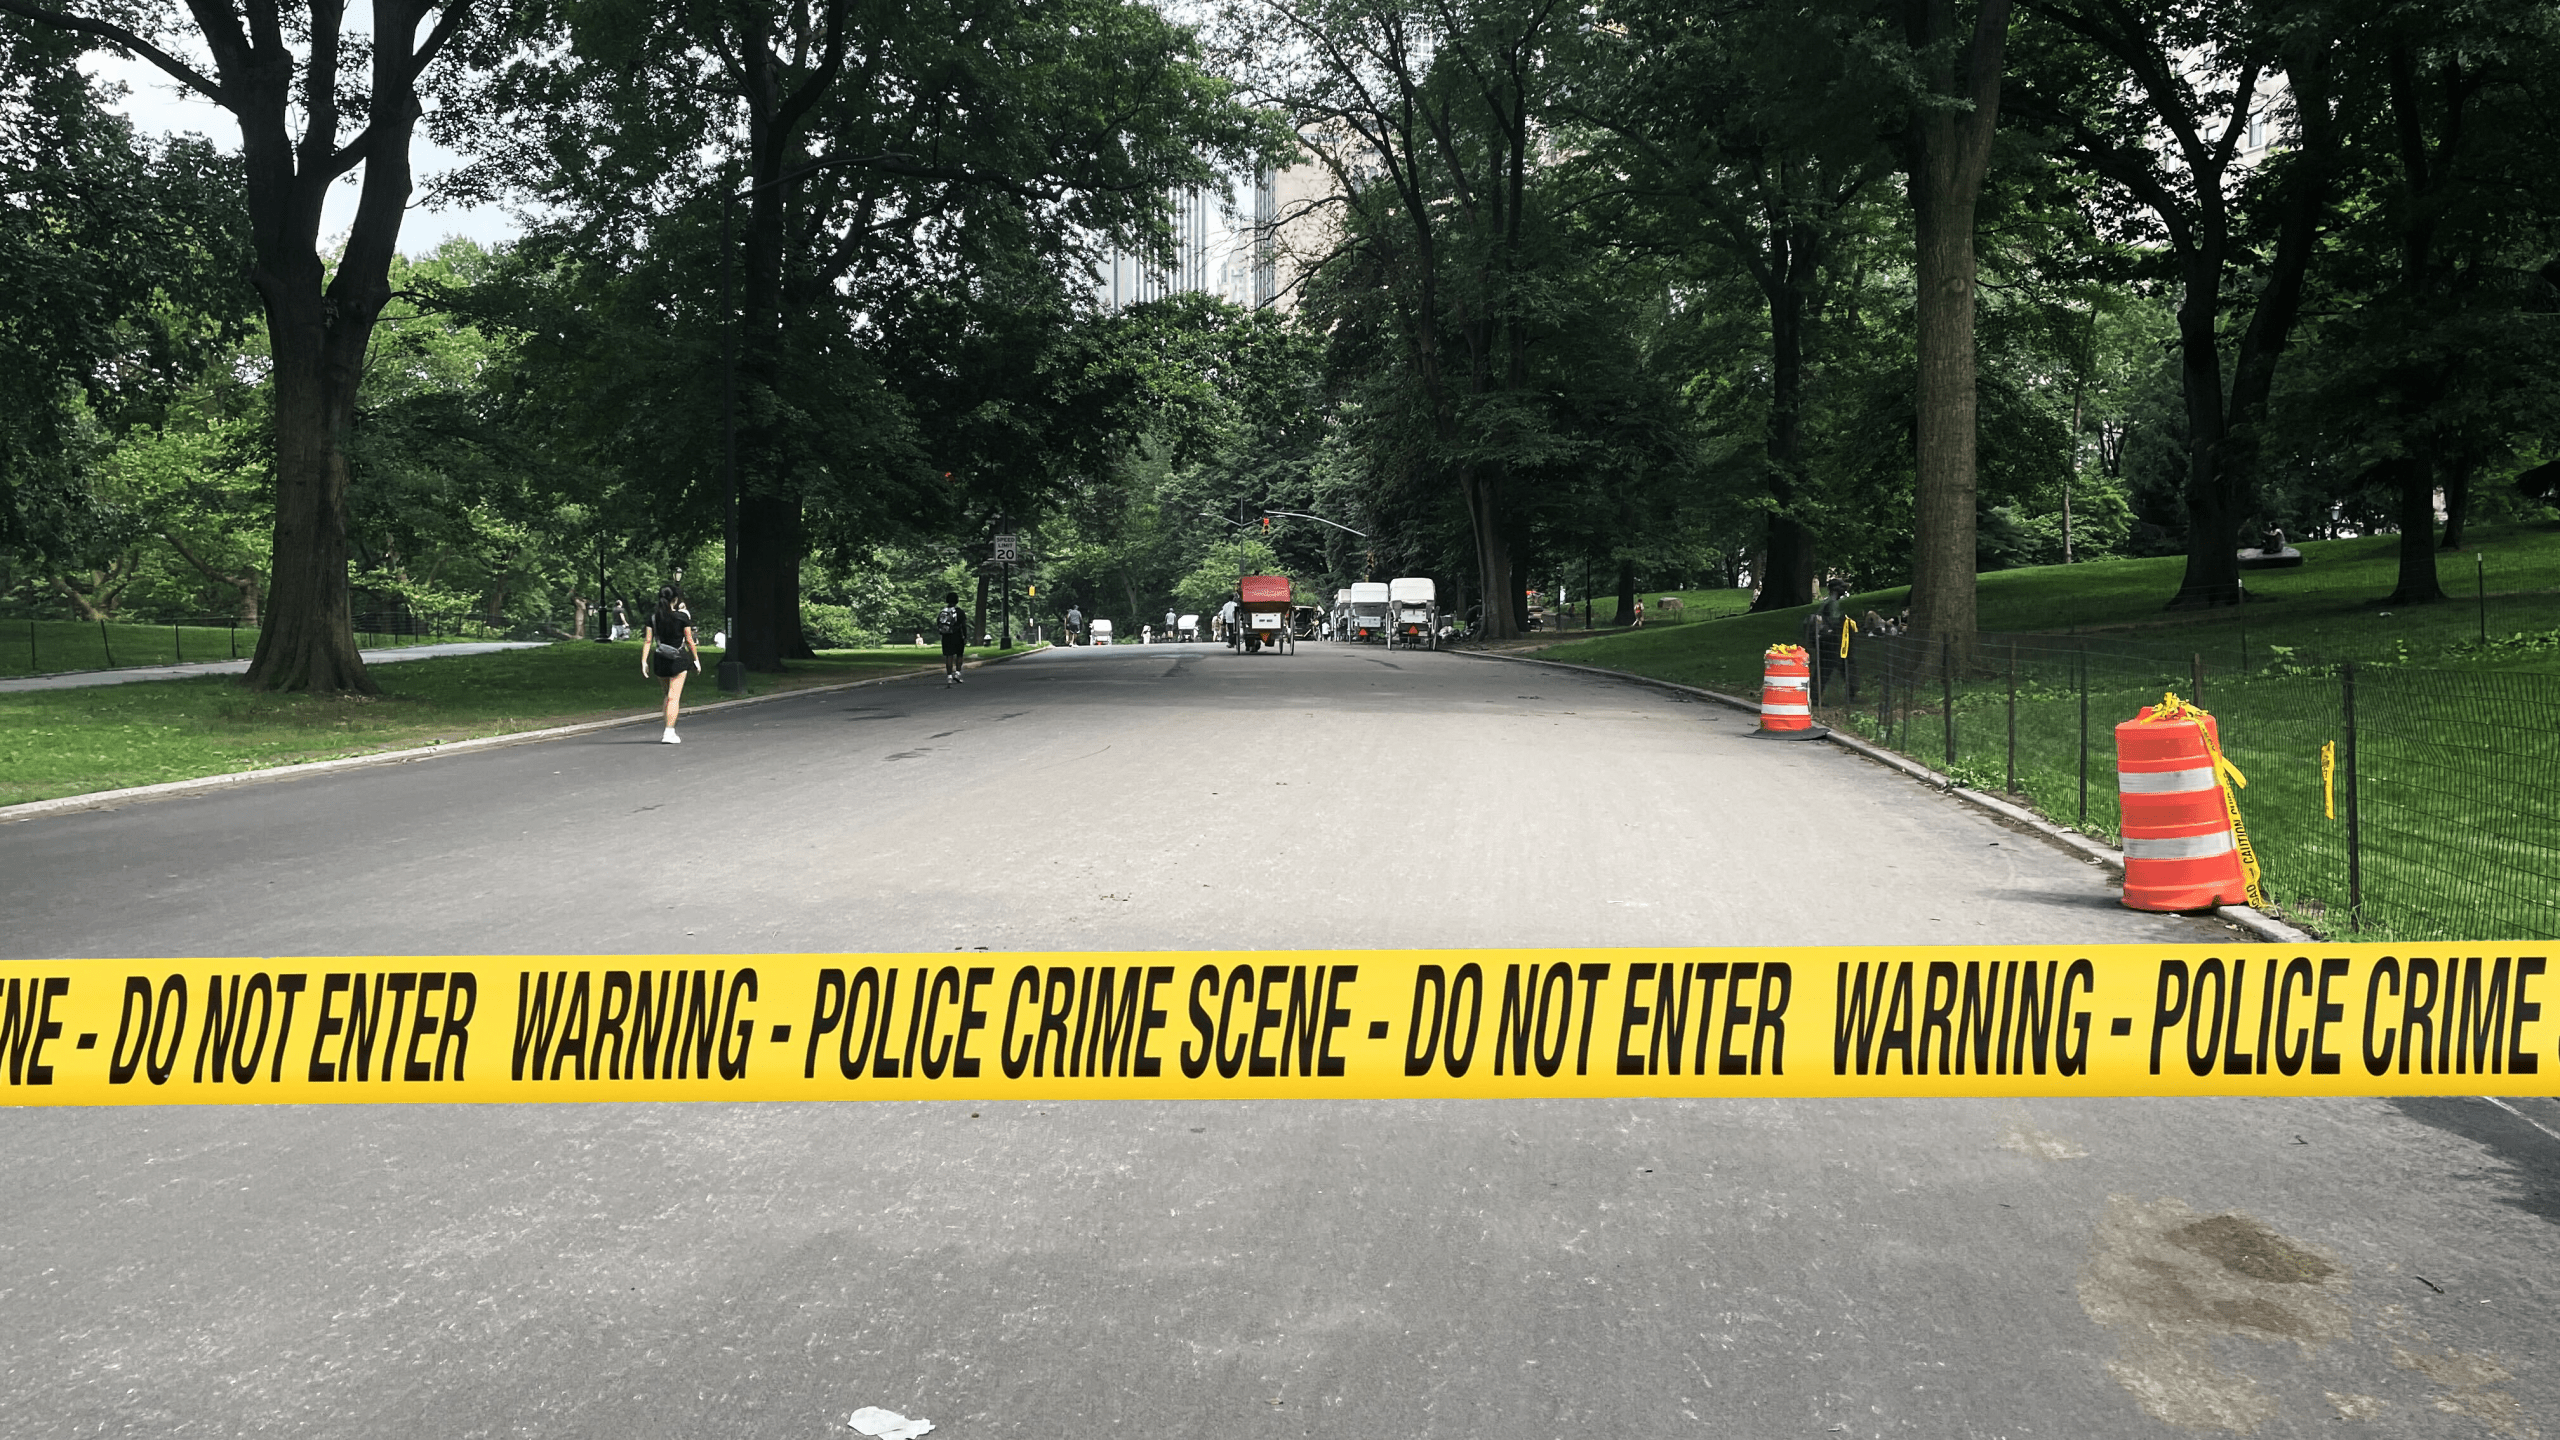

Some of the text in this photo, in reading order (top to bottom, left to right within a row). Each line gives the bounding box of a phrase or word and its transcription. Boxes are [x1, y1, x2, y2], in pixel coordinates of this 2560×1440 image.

[997, 549, 1015, 560] 20
[2233, 819, 2255, 864] CAUTION
[76, 1033, 98, 1050] -
[109, 974, 188, 1085] DO
[193, 973, 308, 1084] NOT
[308, 972, 477, 1083] ENTER
[511, 968, 758, 1081] WARNING
[770, 1025, 792, 1043] -
[804, 966, 995, 1080] POLICE
[1001, 966, 1175, 1079] CRIME
[1180, 965, 1359, 1078] SCENE
[1367, 1022, 1389, 1039] -
[1404, 963, 1483, 1078] DO
[1493, 962, 1611, 1077] NOT
[1616, 962, 1792, 1076] ENTER
[1833, 959, 2094, 1076] WARNING
[2110, 1018, 2132, 1036] -
[2149, 957, 2351, 1076] POLICE
[2362, 957, 2547, 1076] CRIME
